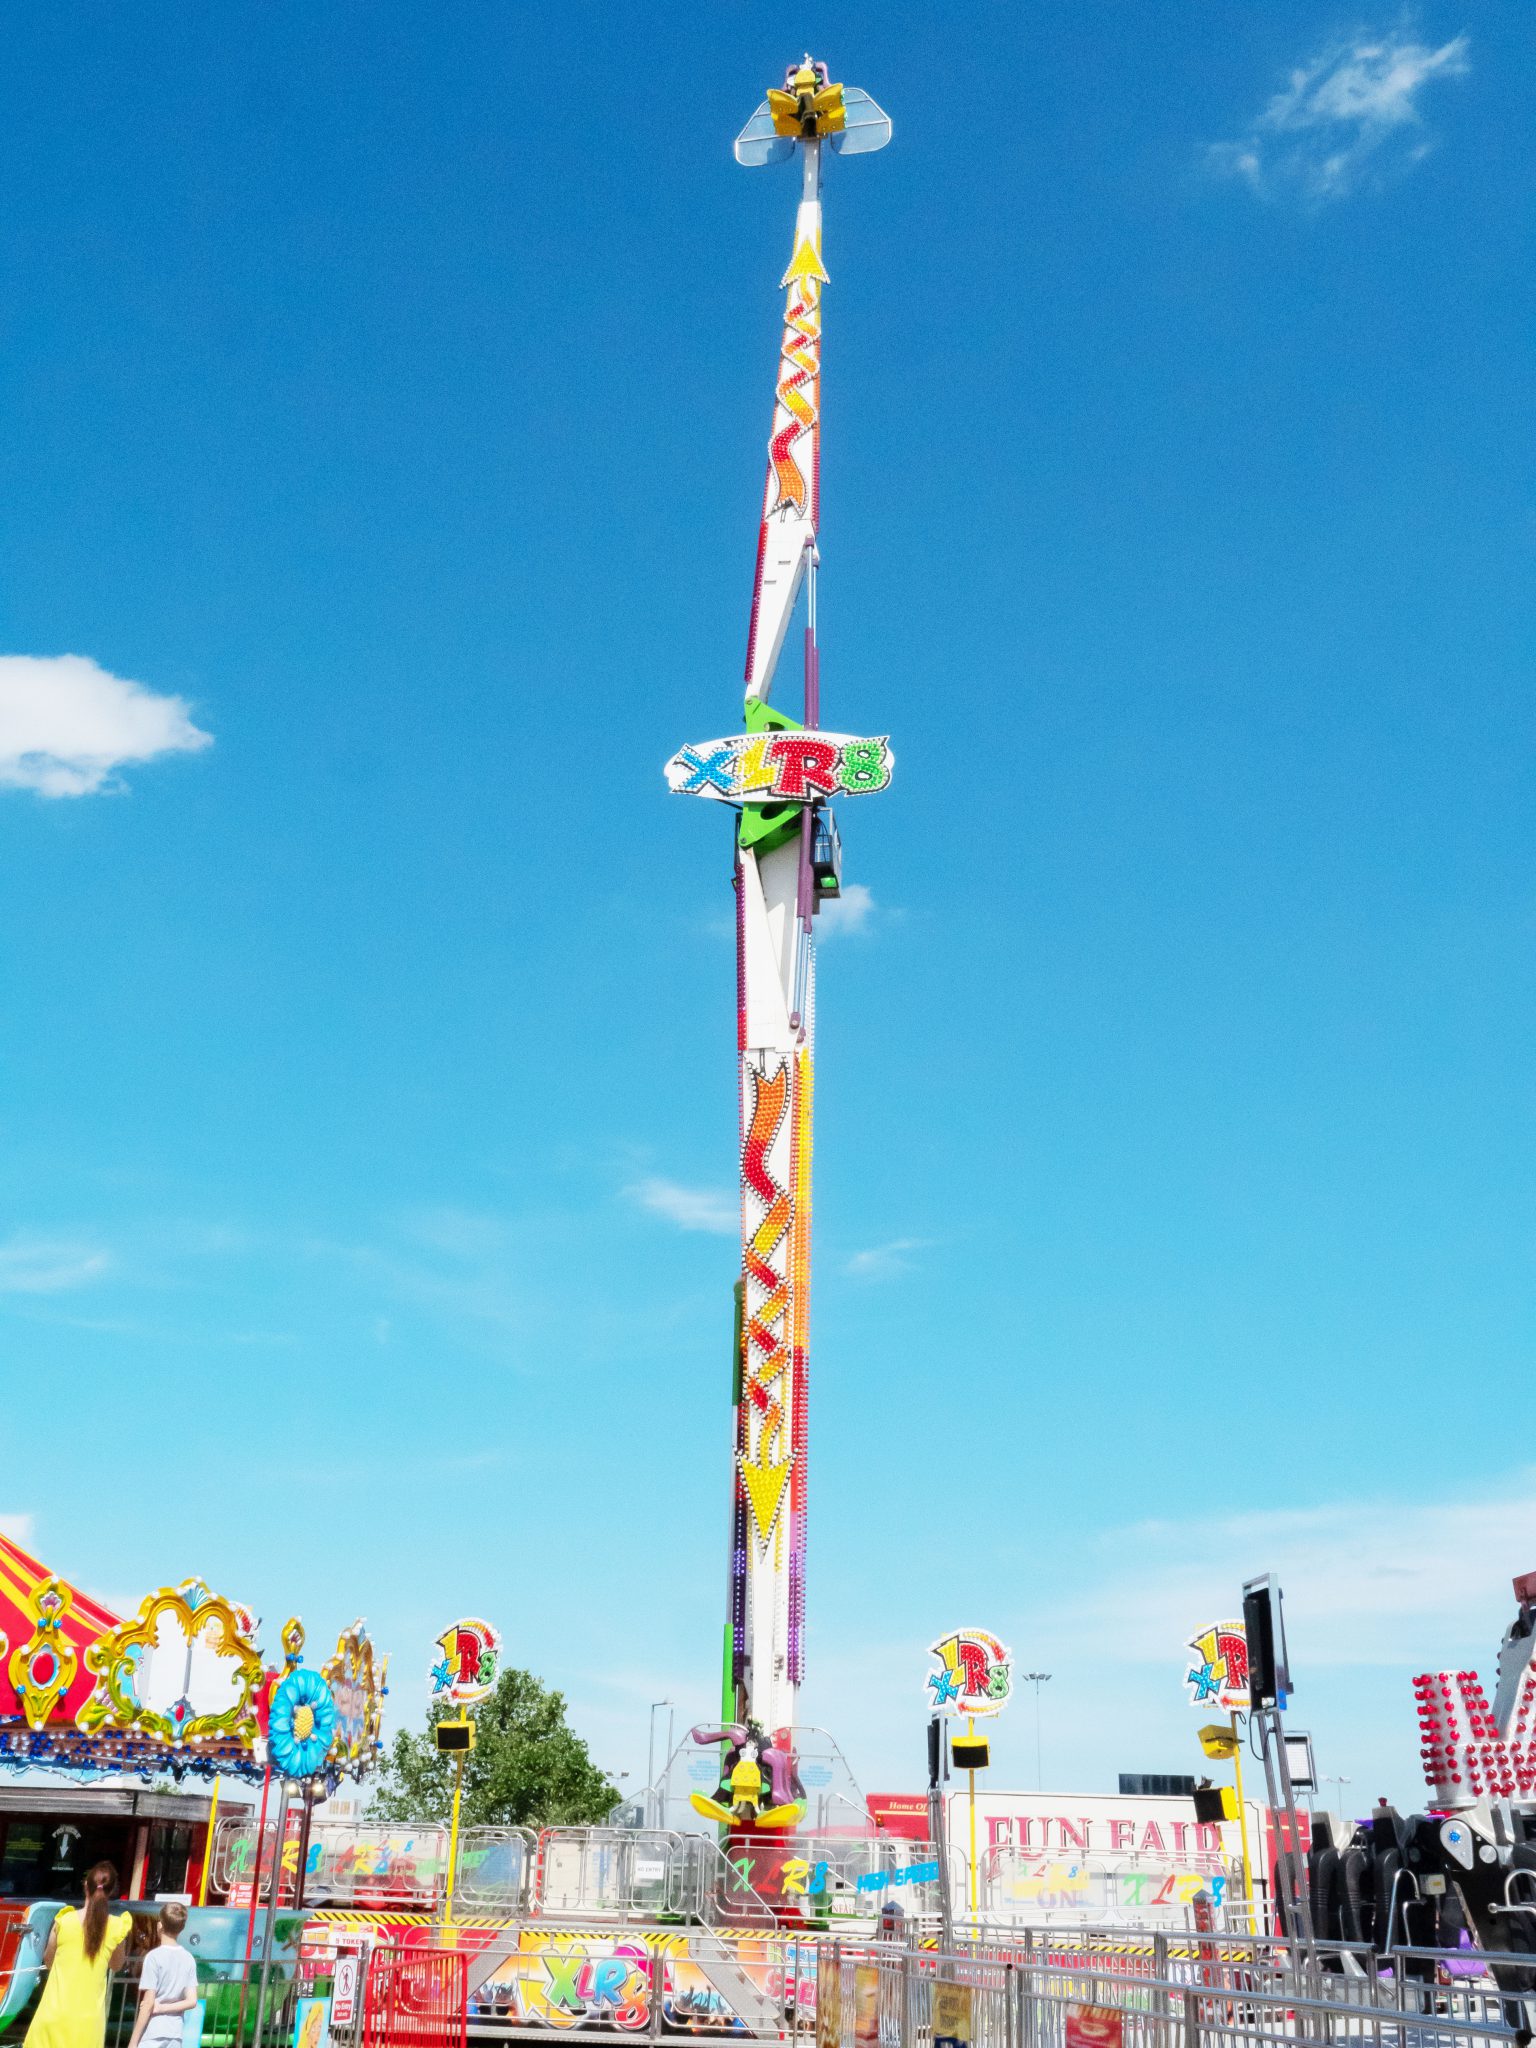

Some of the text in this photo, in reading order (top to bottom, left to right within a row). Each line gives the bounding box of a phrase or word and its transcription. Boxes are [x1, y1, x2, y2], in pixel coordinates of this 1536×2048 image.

[671, 735, 890, 800] XLR8
[430, 1625, 498, 1694] XLR8
[928, 1634, 1009, 1706] XLR8
[1187, 1626, 1249, 1701] XLR
[889, 1801, 928, 1813] Home Of
[732, 1857, 829, 1895] XLR8
[984, 1816, 1228, 1882] FUN FAIR
[541, 1943, 652, 2031] XLR8
